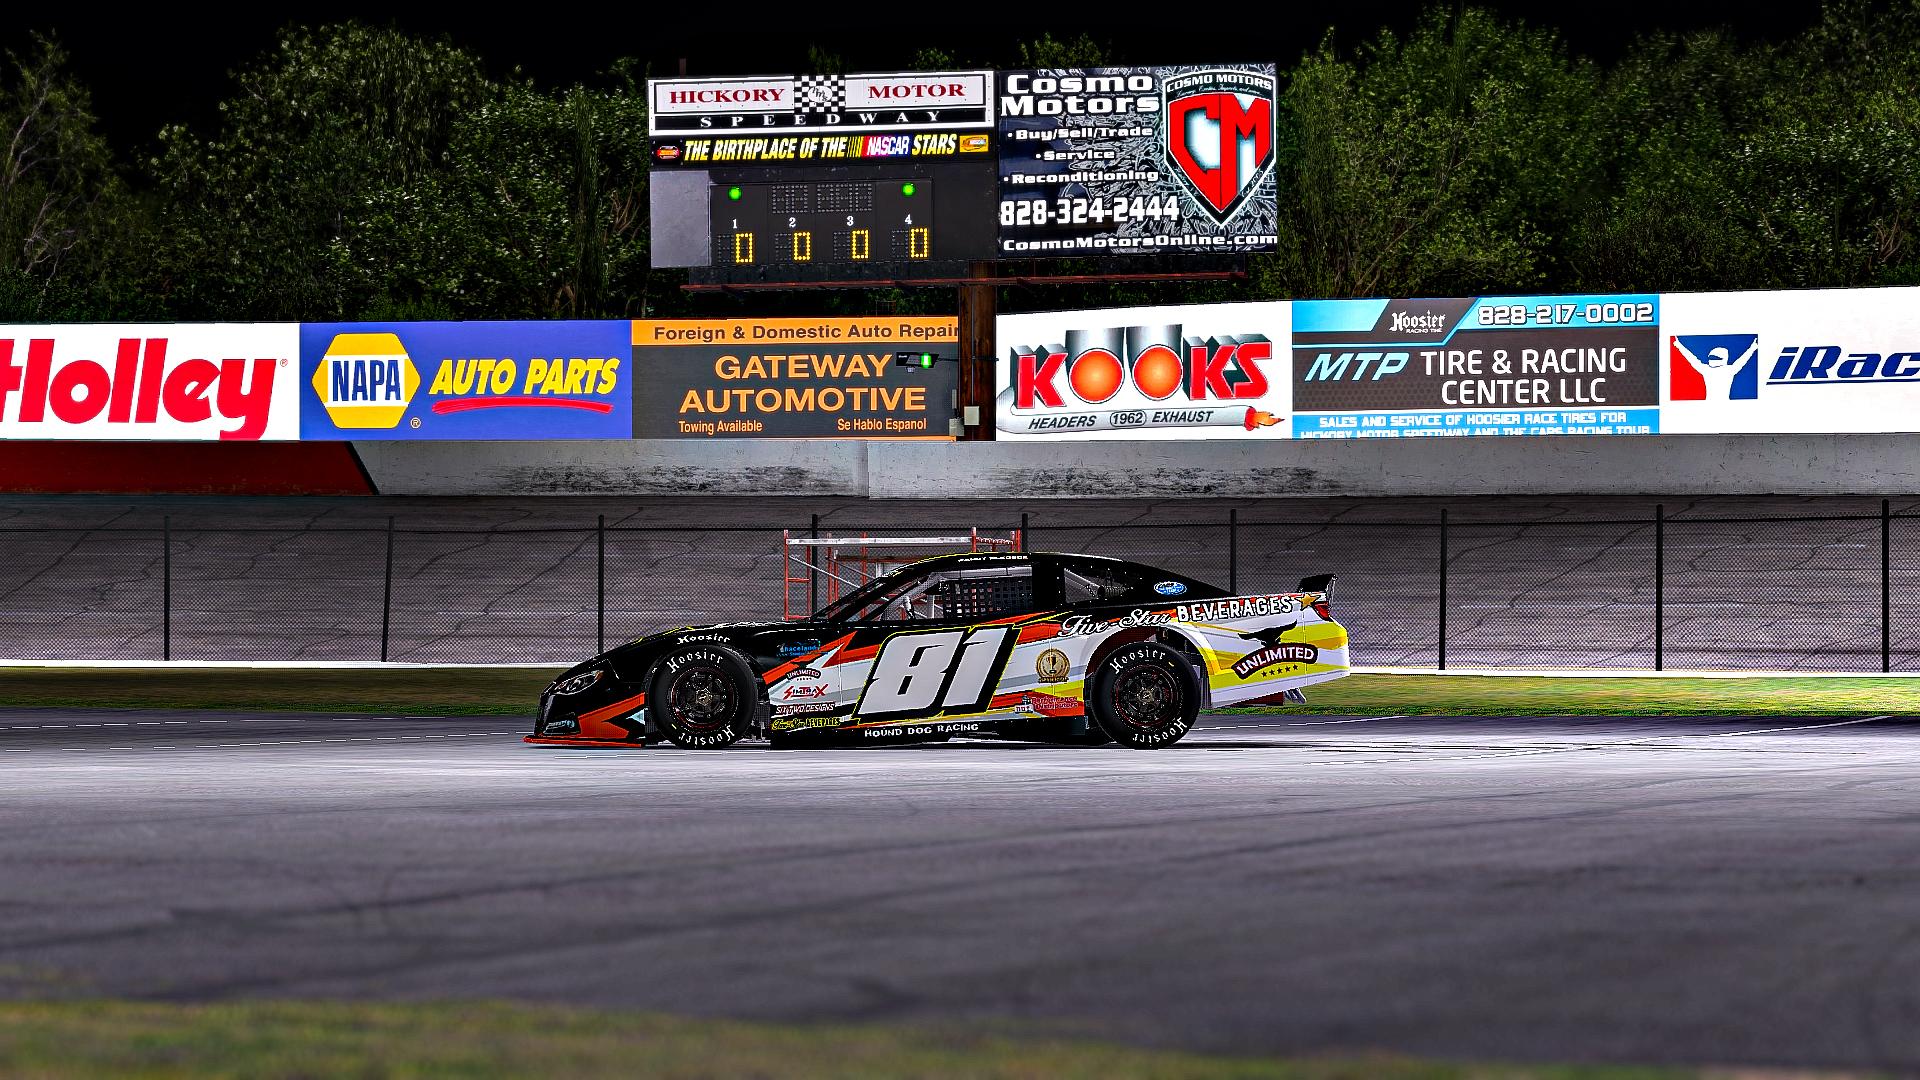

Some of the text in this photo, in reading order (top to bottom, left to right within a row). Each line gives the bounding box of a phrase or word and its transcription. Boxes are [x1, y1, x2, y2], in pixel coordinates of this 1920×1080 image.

[669, 83, 966, 104] HICKORY MOTOR
[1007, 74, 1153, 95] Cosmo
[1166, 74, 1213, 93] COSMO
[1216, 74, 1272, 91] MOTORS
[1000, 95, 1160, 117] Motors
[700, 110, 941, 128] SPEEDWAY
[1015, 127, 1153, 141] Buy/Sell/Trade
[684, 140, 710, 161] THE
[713, 137, 796, 160] BIRTHPLACE
[800, 137, 816, 159] OF
[820, 136, 848, 158] THE
[866, 135, 911, 156] NASCAR
[912, 133, 958, 156] STARS
[1043, 150, 1116, 162] Service
[1169, 93, 1272, 213] CM
[1012, 170, 1159, 184] Reconditioning
[732, 214, 913, 229] 1 2 3 4
[1000, 196, 1180, 226] 828-324-2444
[736, 227, 928, 264] 0 0 0 0
[1003, 234, 1278, 251] CosmoMotorsOnline.com
[1389, 310, 1446, 331] Hoosier
[1477, 303, 1655, 325] 828-217-0002
[654, 326, 726, 342] Foreign
[733, 325, 745, 340] &
[753, 324, 844, 340] Domestic
[847, 324, 893, 338] Auto
[714, 353, 893, 380] GATEWAY
[1014, 336, 1272, 409] KOOKS
[1304, 352, 1411, 382] MTP
[1420, 347, 1627, 376] TIRE & RACING
[0, 338, 278, 441] Holley
[332, 357, 621, 402] NAPA AUTO PARTS
[1441, 377, 1607, 405] CENTER LLC
[679, 387, 927, 414] AUTOMOTIVE
[679, 416, 927, 436] Towing Available Se Hablo Espanol
[1028, 410, 1214, 430] HEADERS 1962 EXHAUST
[1319, 411, 1627, 428] SALES AND SERVICE OF HOOSIER RACE TIRES FOR
[1177, 595, 1293, 622] BEVERAGES
[677, 633, 731, 645] Hoosier
[666, 648, 724, 674] Hoosier
[857, 627, 1009, 715] 81
[1109, 645, 1166, 675] Hoosier
[1236, 646, 1315, 675] UNLIMITED
[786, 669, 820, 680] UNLIMITED
[678, 723, 736, 749] Hoosier
[864, 723, 980, 738] HOUND DOG RACING
[1132, 716, 1188, 747] Hoosier
